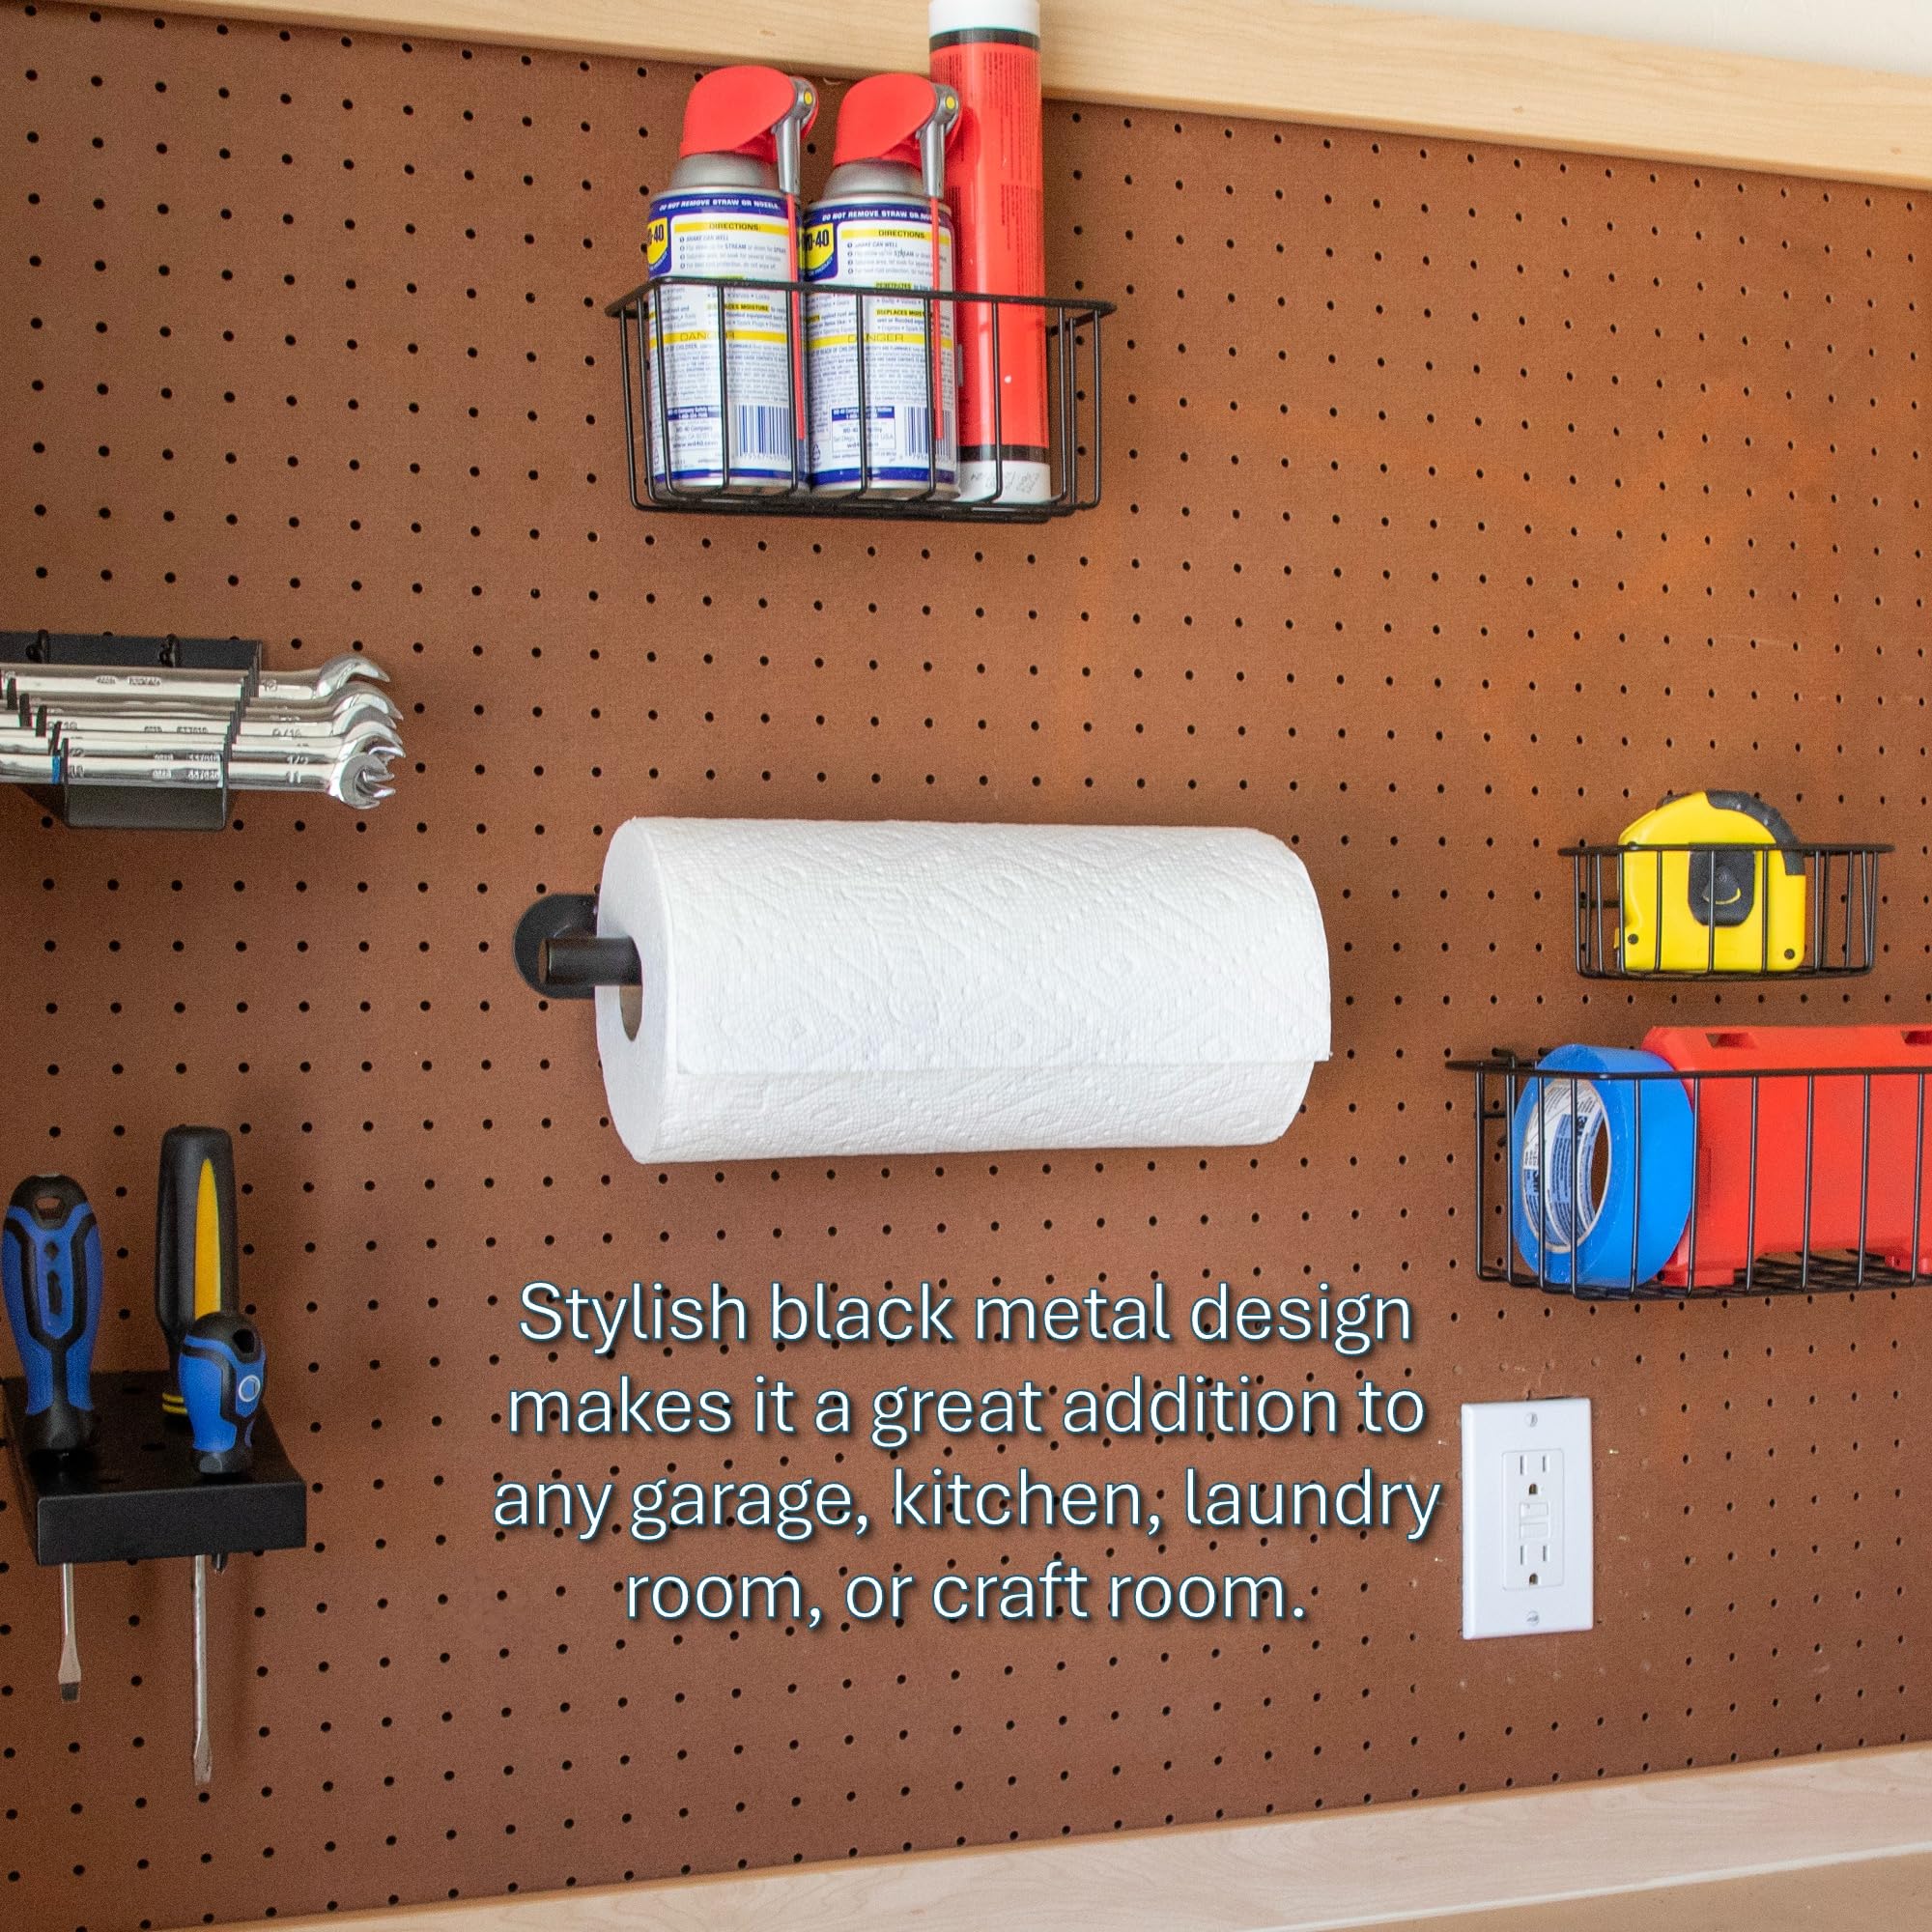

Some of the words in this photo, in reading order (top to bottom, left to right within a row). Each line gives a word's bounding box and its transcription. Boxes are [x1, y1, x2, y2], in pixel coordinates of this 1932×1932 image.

[803, 228, 830, 251] D-40
[680, 331, 735, 342] DANR
[847, 332, 904, 343] DNGER
